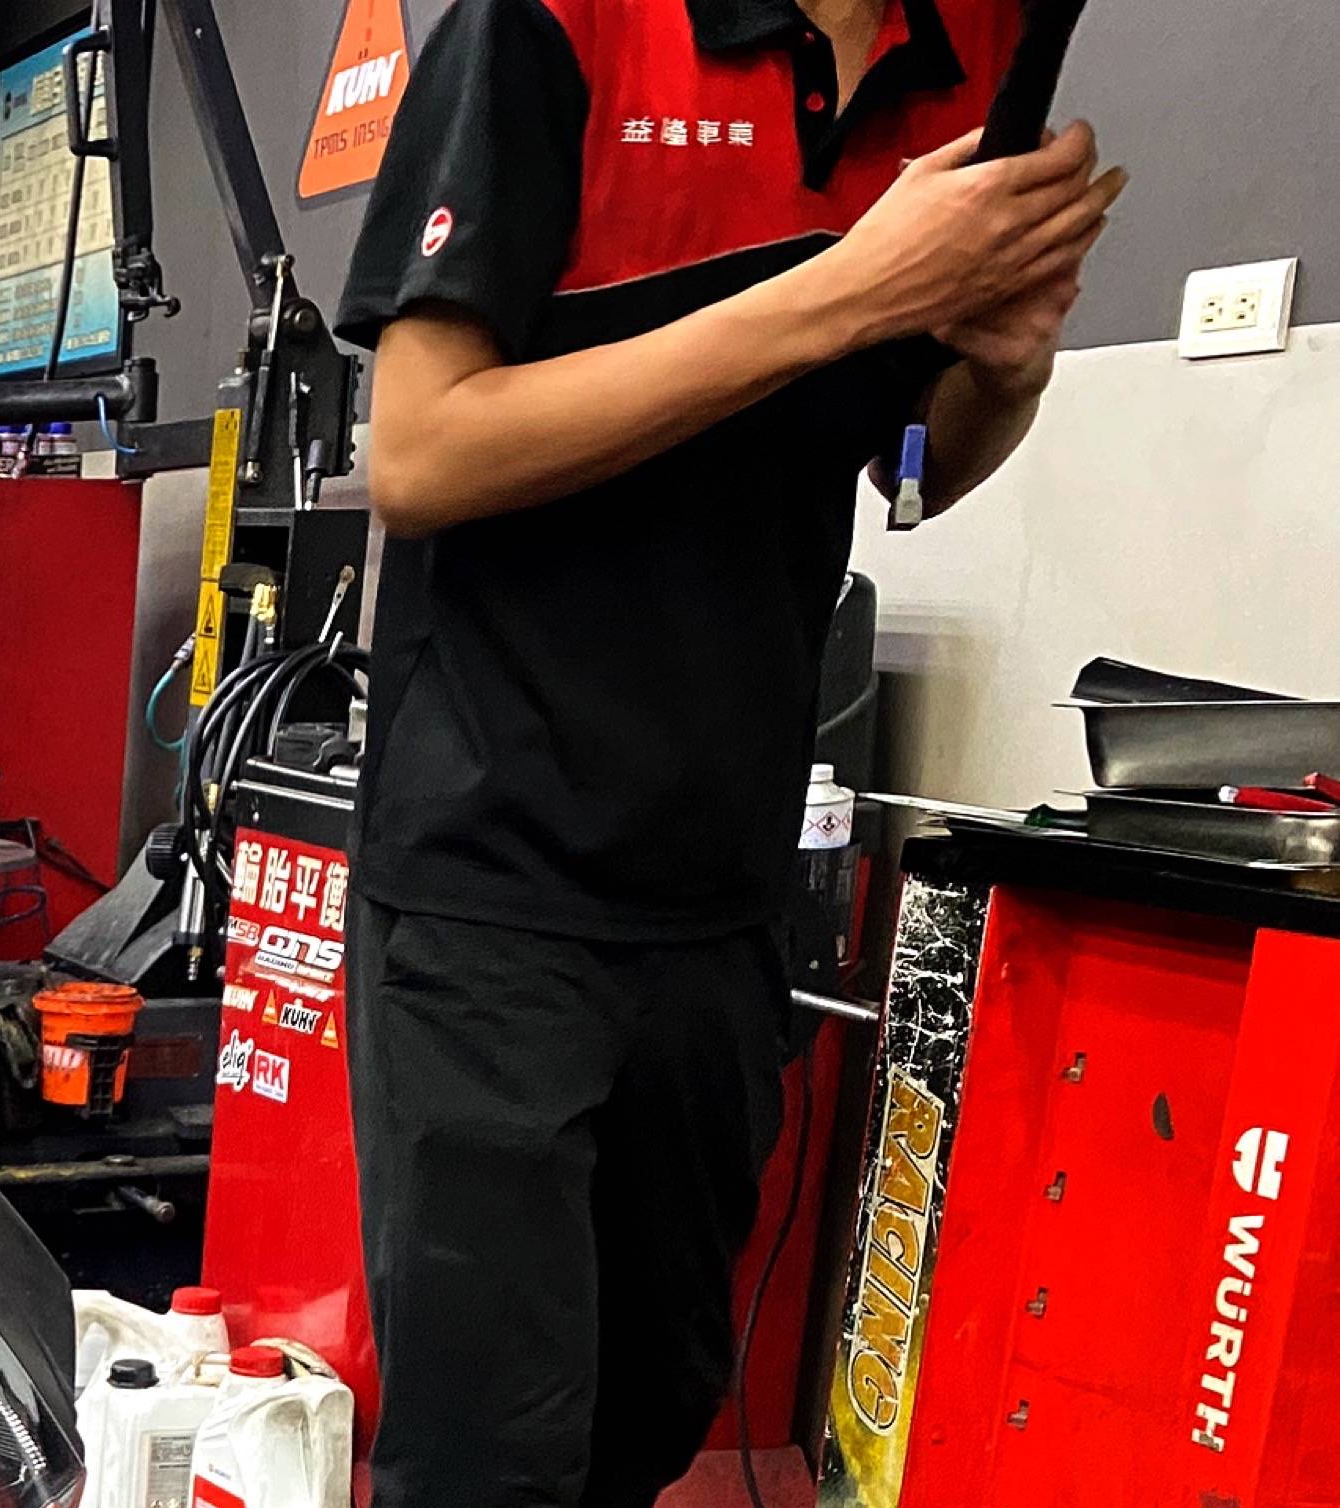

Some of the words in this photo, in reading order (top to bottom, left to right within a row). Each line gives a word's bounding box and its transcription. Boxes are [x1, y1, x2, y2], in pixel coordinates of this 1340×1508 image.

[620, 116, 754, 147] 益隆車業
[230, 840, 350, 932] 輪胎平衡
[255, 1055, 286, 1091] RK
[848, 1064, 945, 1436] RACING
[1191, 1215, 1265, 1452] WÜRTH
